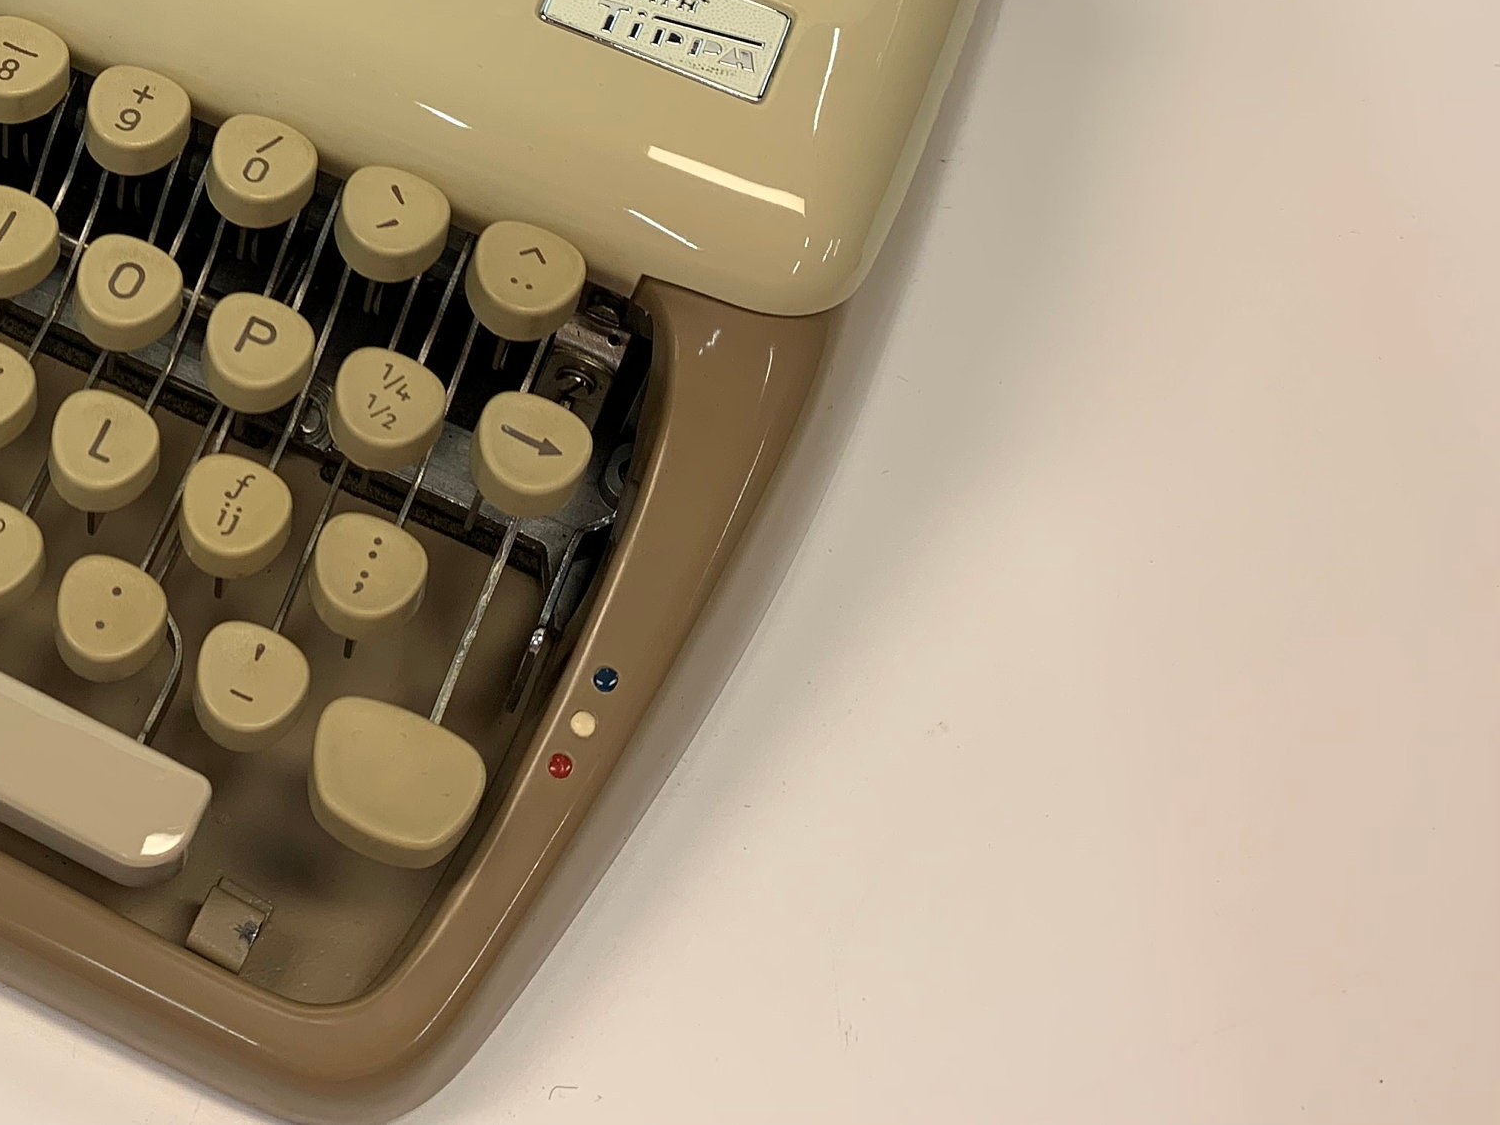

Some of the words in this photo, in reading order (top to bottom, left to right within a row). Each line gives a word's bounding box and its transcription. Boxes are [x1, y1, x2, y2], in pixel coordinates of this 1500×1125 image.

[114, 108, 142, 132] 9
[107, 261, 146, 300] O
[233, 315, 278, 353] P
[88, 418, 112, 464] L
